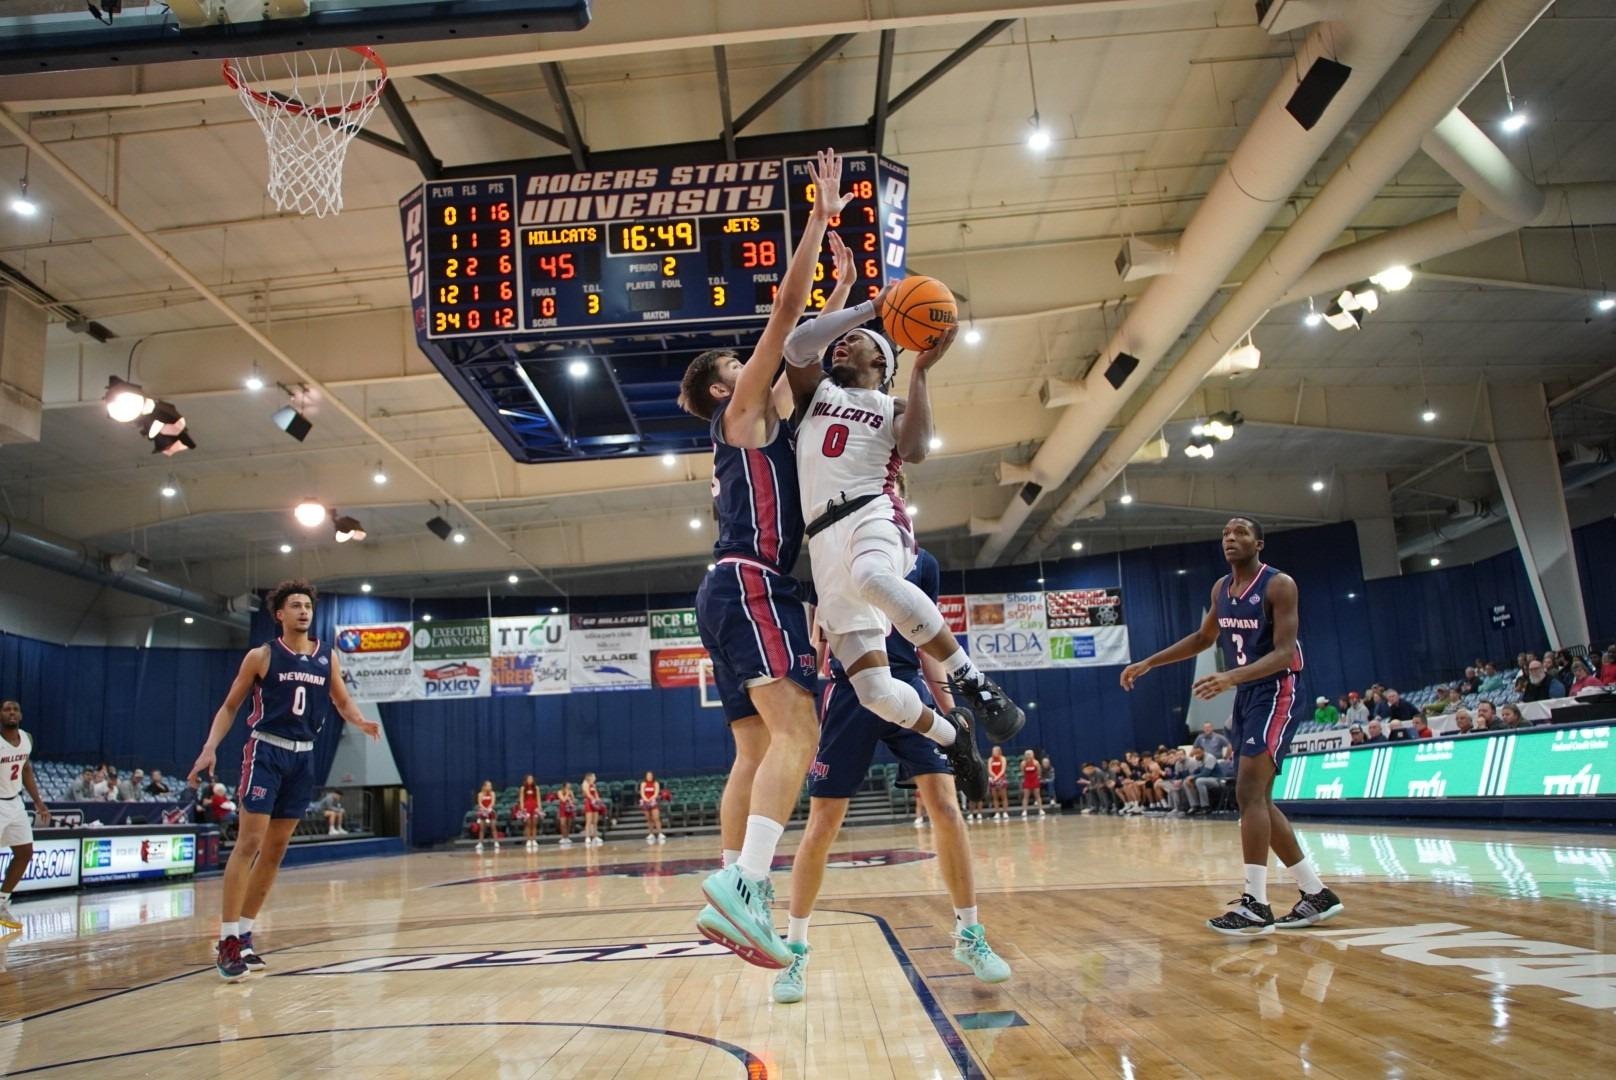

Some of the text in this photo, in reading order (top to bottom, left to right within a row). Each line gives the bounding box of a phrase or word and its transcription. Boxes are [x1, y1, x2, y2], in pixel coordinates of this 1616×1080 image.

[850, 161, 867, 172] PTS
[526, 160, 782, 196] ROGERS STATE
[432, 186, 454, 198] PLYR
[462, 184, 477, 196] FLS
[488, 183, 504, 194] PTS
[853, 181, 873, 199] 18
[519, 184, 774, 225] UNIVERSITY
[444, 203, 510, 226] 0 1 16
[863, 207, 874, 224] 7
[723, 217, 760, 233] JETS
[451, 229, 511, 250] 1 1 3
[528, 228, 597, 245] HILLCATS
[622, 222, 693, 251] 16:49
[864, 233, 876, 251] 2
[742, 240, 776, 268] 38
[446, 255, 512, 278] 2 2 6
[540, 253, 576, 279] 45
[629, 263, 658, 273] PERIOD
[663, 256, 677, 276] 2
[865, 259, 878, 278] 6
[626, 279, 683, 290] PLAYER FOUL
[753, 273, 778, 283] FOULS
[440, 281, 513, 304] 12 1 6
[531, 286, 557, 297] FOULS
[713, 286, 726, 306] 3
[541, 297, 555, 316] 0
[587, 294, 600, 314] 3
[755, 304, 773, 314] SCO
[435, 308, 514, 332] 34 0 12
[532, 318, 558, 328] SCORE
[643, 311, 670, 320] MATCH
[812, 402, 884, 430] HILLCATS
[822, 423, 850, 458] 0
[1006, 593, 1037, 602] Shop
[1017, 603, 1043, 612] Dine
[652, 614, 680, 627] RCB
[1218, 617, 1259, 629] NEWMAN
[433, 625, 488, 637] EXECUTIVE
[498, 618, 562, 646] TTCU
[431, 636, 488, 648] LAWN CARE
[976, 632, 1042, 653] GRDA
[1231, 633, 1247, 666] 3
[582, 653, 638, 662] VILLAGE
[278, 671, 326, 686] NEWMAN
[355, 668, 411, 677] ADVANCED
[292, 686, 307, 716] 0
[10, 764, 19, 781] 2
